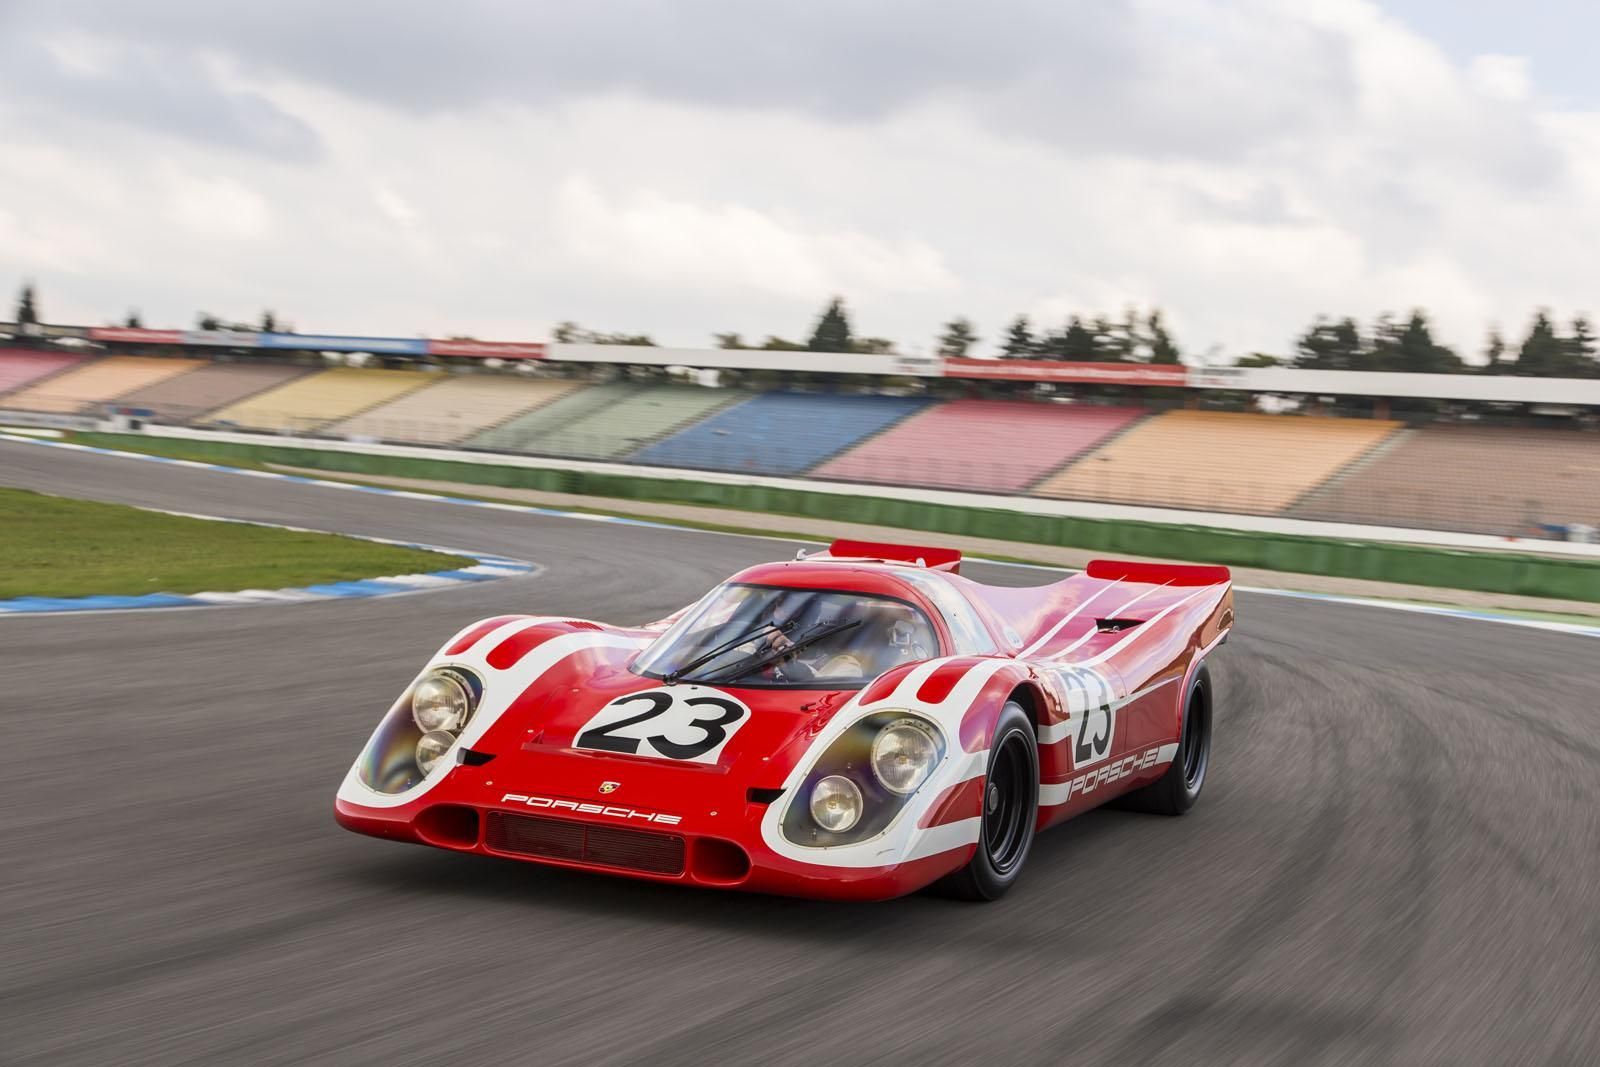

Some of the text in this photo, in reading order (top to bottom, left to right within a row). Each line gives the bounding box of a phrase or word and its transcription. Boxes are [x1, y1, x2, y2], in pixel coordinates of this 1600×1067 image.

[576, 691, 744, 760] 23
[1061, 667, 1112, 763] 23
[1069, 748, 1159, 796] PORSCHE
[502, 794, 682, 825] PORSCHE
